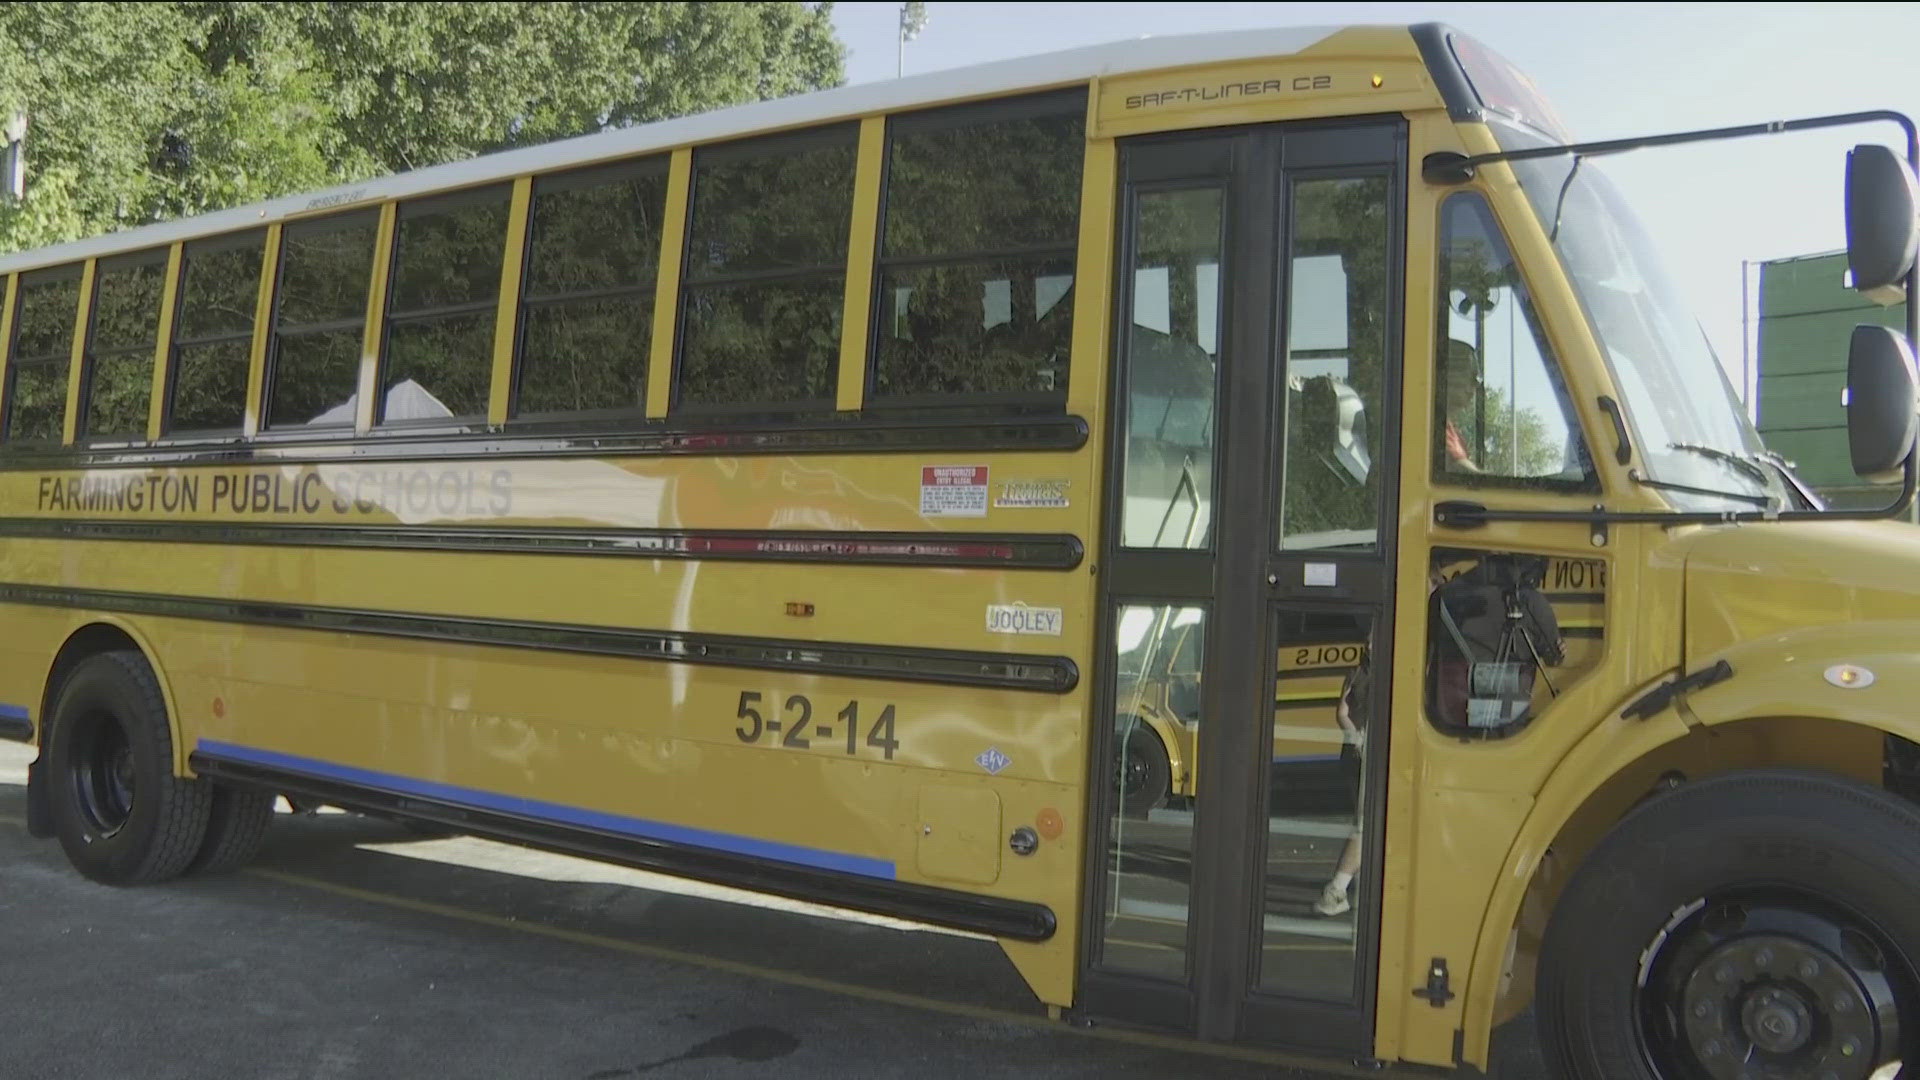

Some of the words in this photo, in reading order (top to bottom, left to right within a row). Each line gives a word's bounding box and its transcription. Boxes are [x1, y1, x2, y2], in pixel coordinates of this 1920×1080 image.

[1126, 79, 1281, 109] SAF-T-LINER
[1292, 76, 1331, 91] C2
[934, 468, 976, 477] UNAUTHORIZED
[936, 477, 951, 485] ENTRY
[953, 477, 972, 485] ILLEGAL
[38, 475, 198, 513] FARMINGTON
[212, 472, 322, 514] PUBLIC
[332, 469, 513, 516] SCHOOLS
[736, 690, 899, 760] 5-2-14
